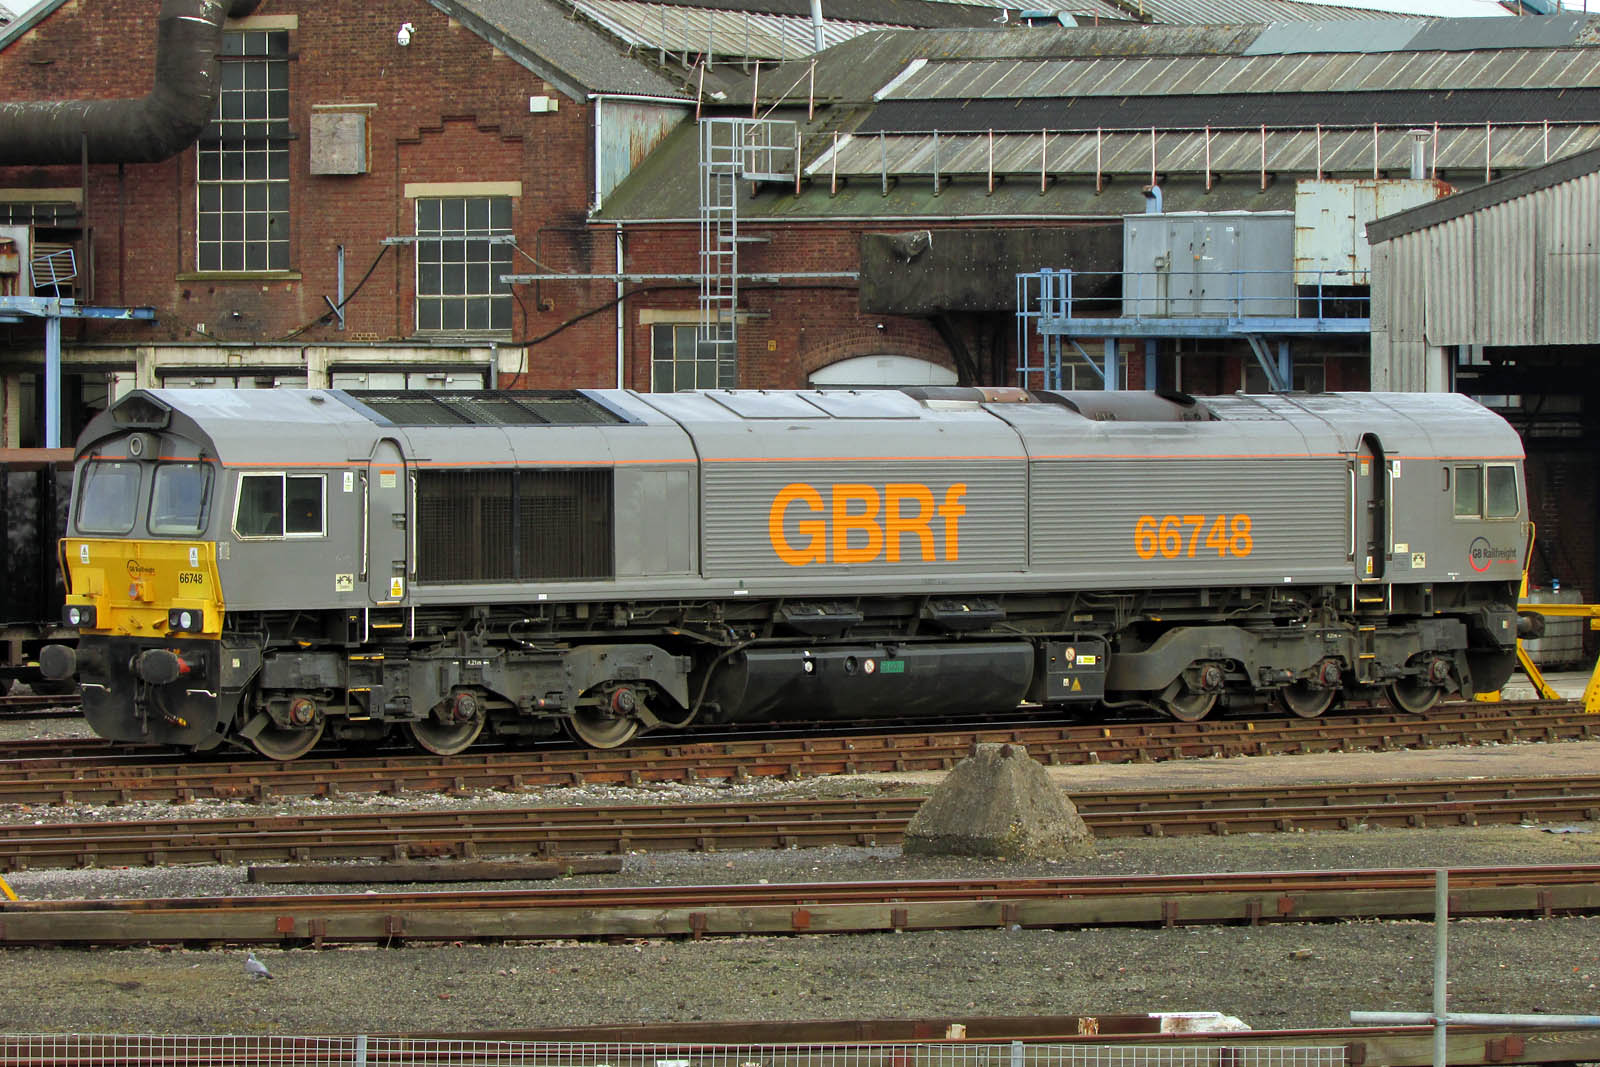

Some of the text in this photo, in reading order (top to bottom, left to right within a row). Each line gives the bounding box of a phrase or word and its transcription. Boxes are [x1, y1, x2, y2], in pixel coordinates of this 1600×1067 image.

[768, 482, 968, 566] GBRf
[1134, 514, 1254, 560] 66748
[1472, 548, 1516, 560] GB Railfreight
[179, 573, 203, 584] 66748
